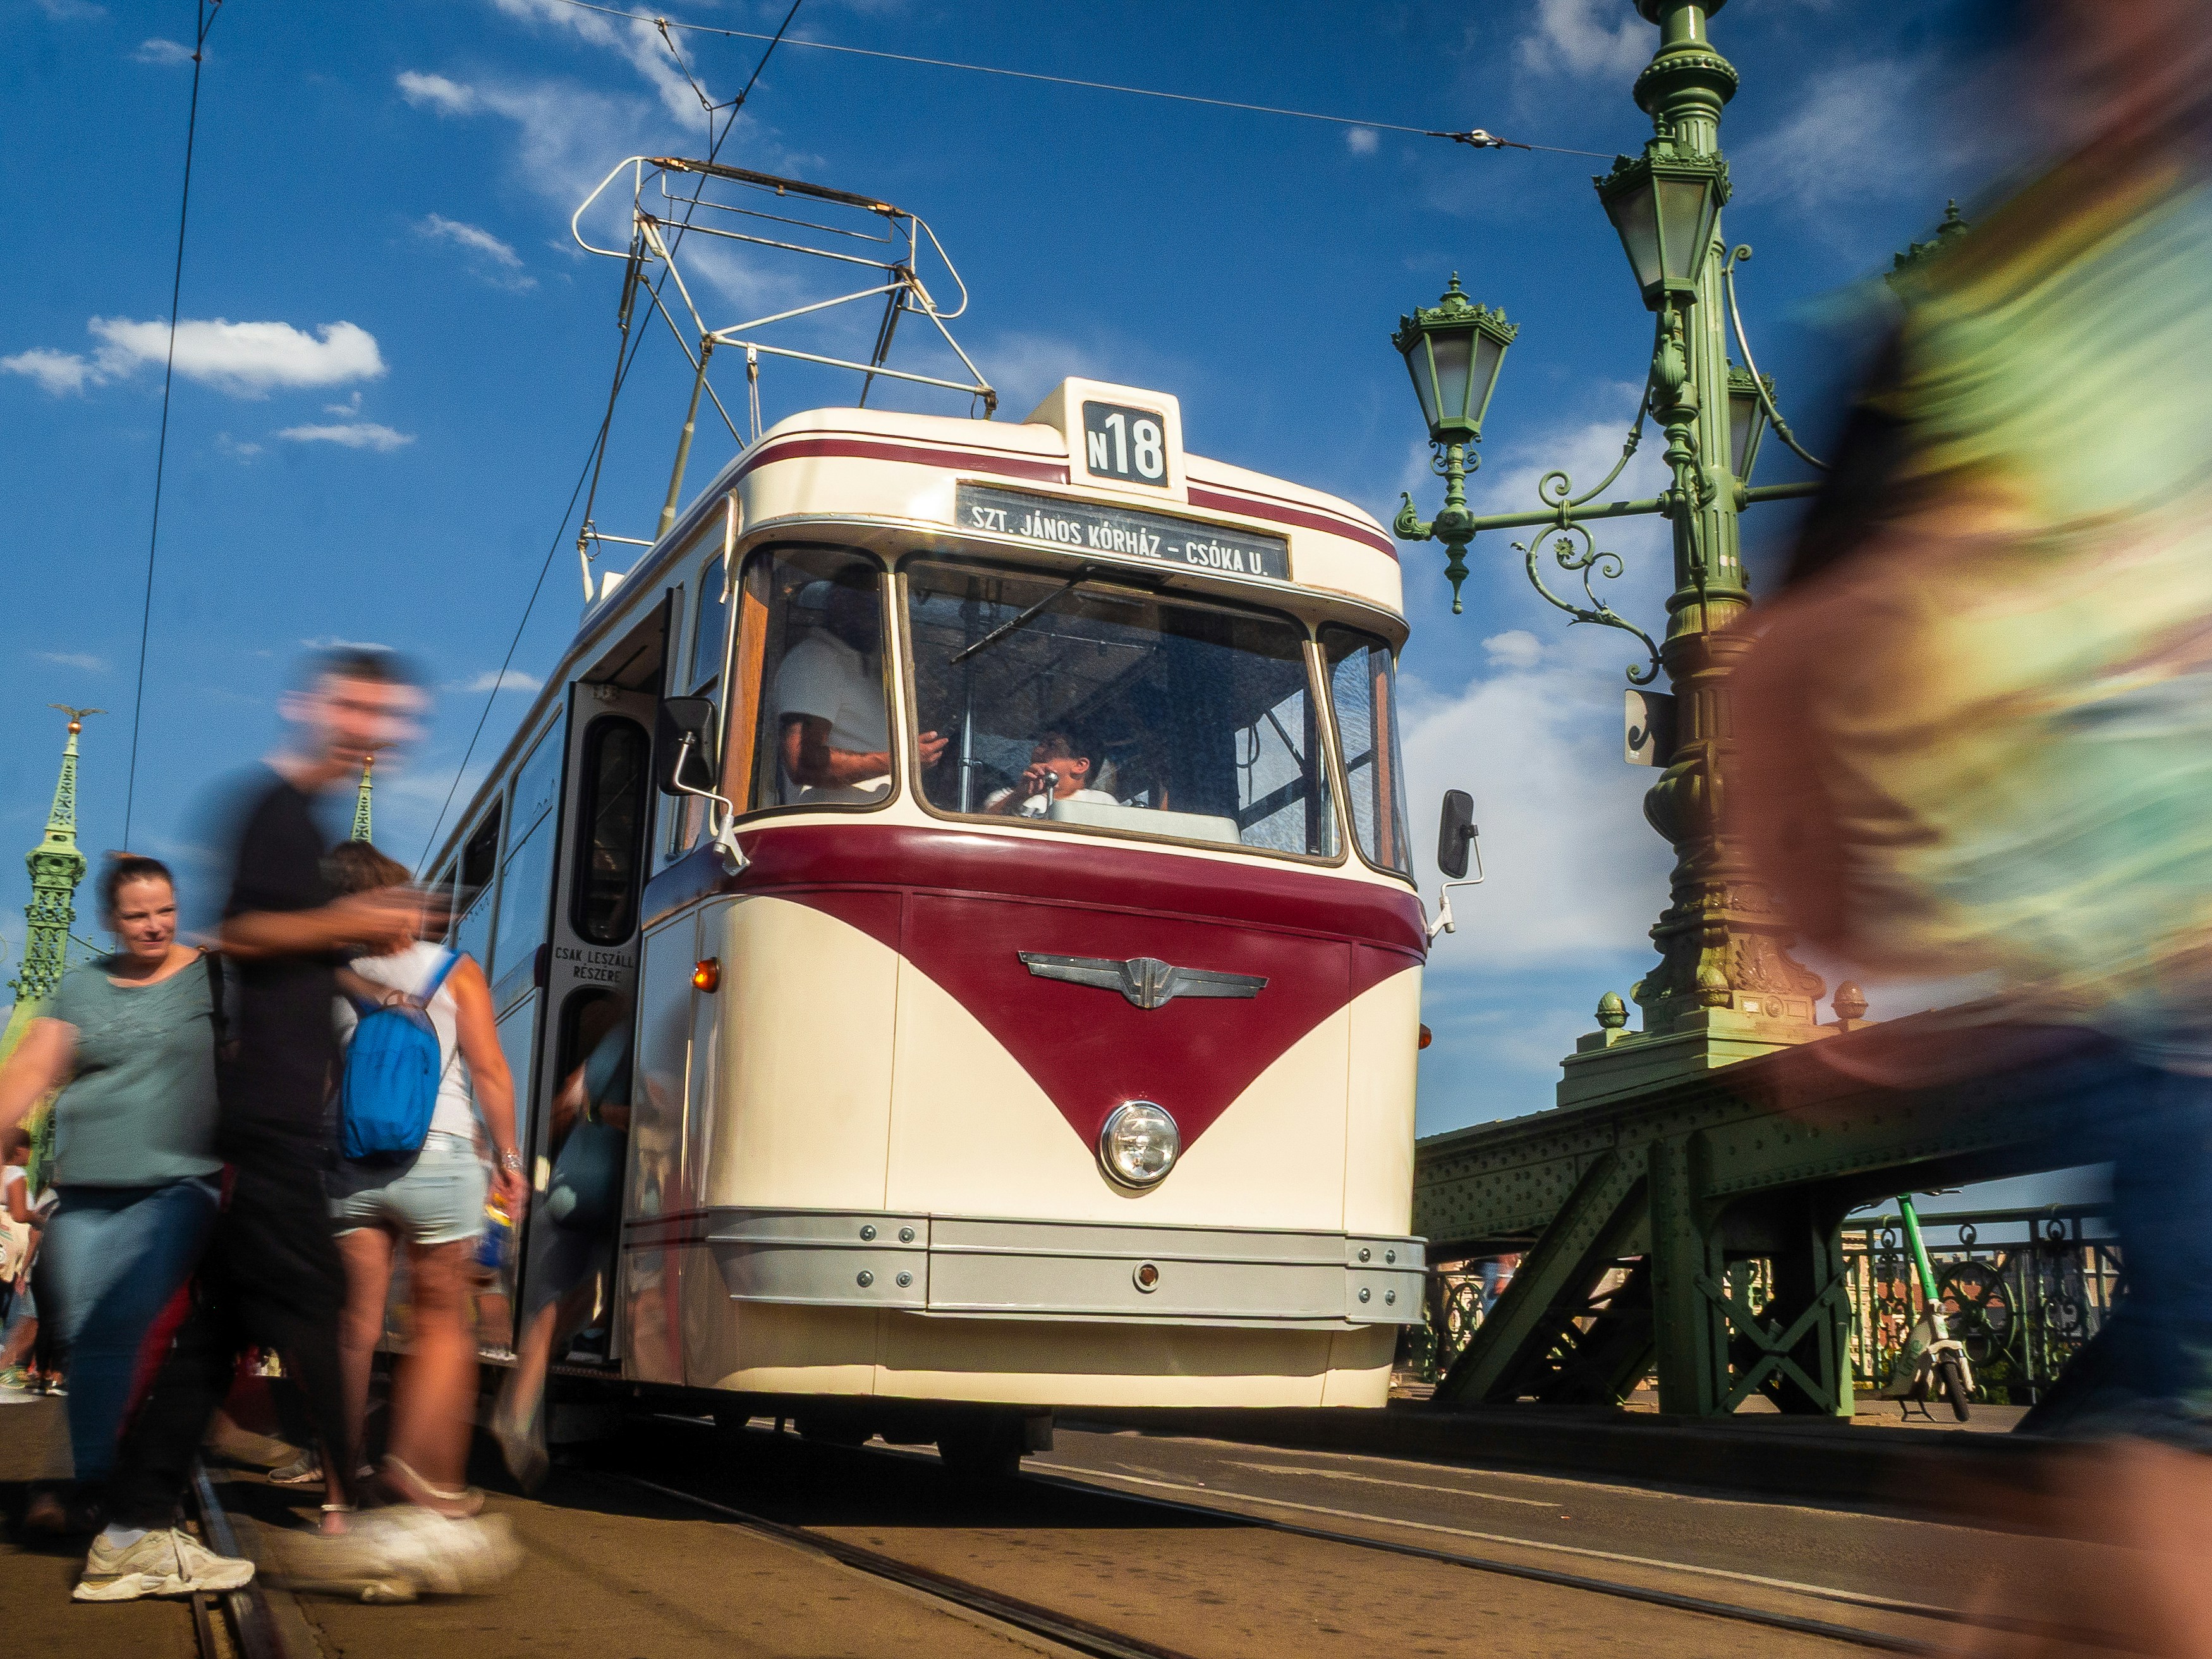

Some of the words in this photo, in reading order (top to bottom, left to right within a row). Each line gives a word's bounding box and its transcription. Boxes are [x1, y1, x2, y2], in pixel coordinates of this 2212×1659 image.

[972, 506, 1014, 533] SZT.
[1020, 509, 1083, 545] JÁNOS
[1088, 521, 1162, 558] KÓRHÁZ
[1186, 540, 1243, 572] CSÓKA
[1249, 553, 1268, 576] U.
[555, 947, 582, 961] CSAK
[573, 963, 622, 982] RÉSZÉRE
